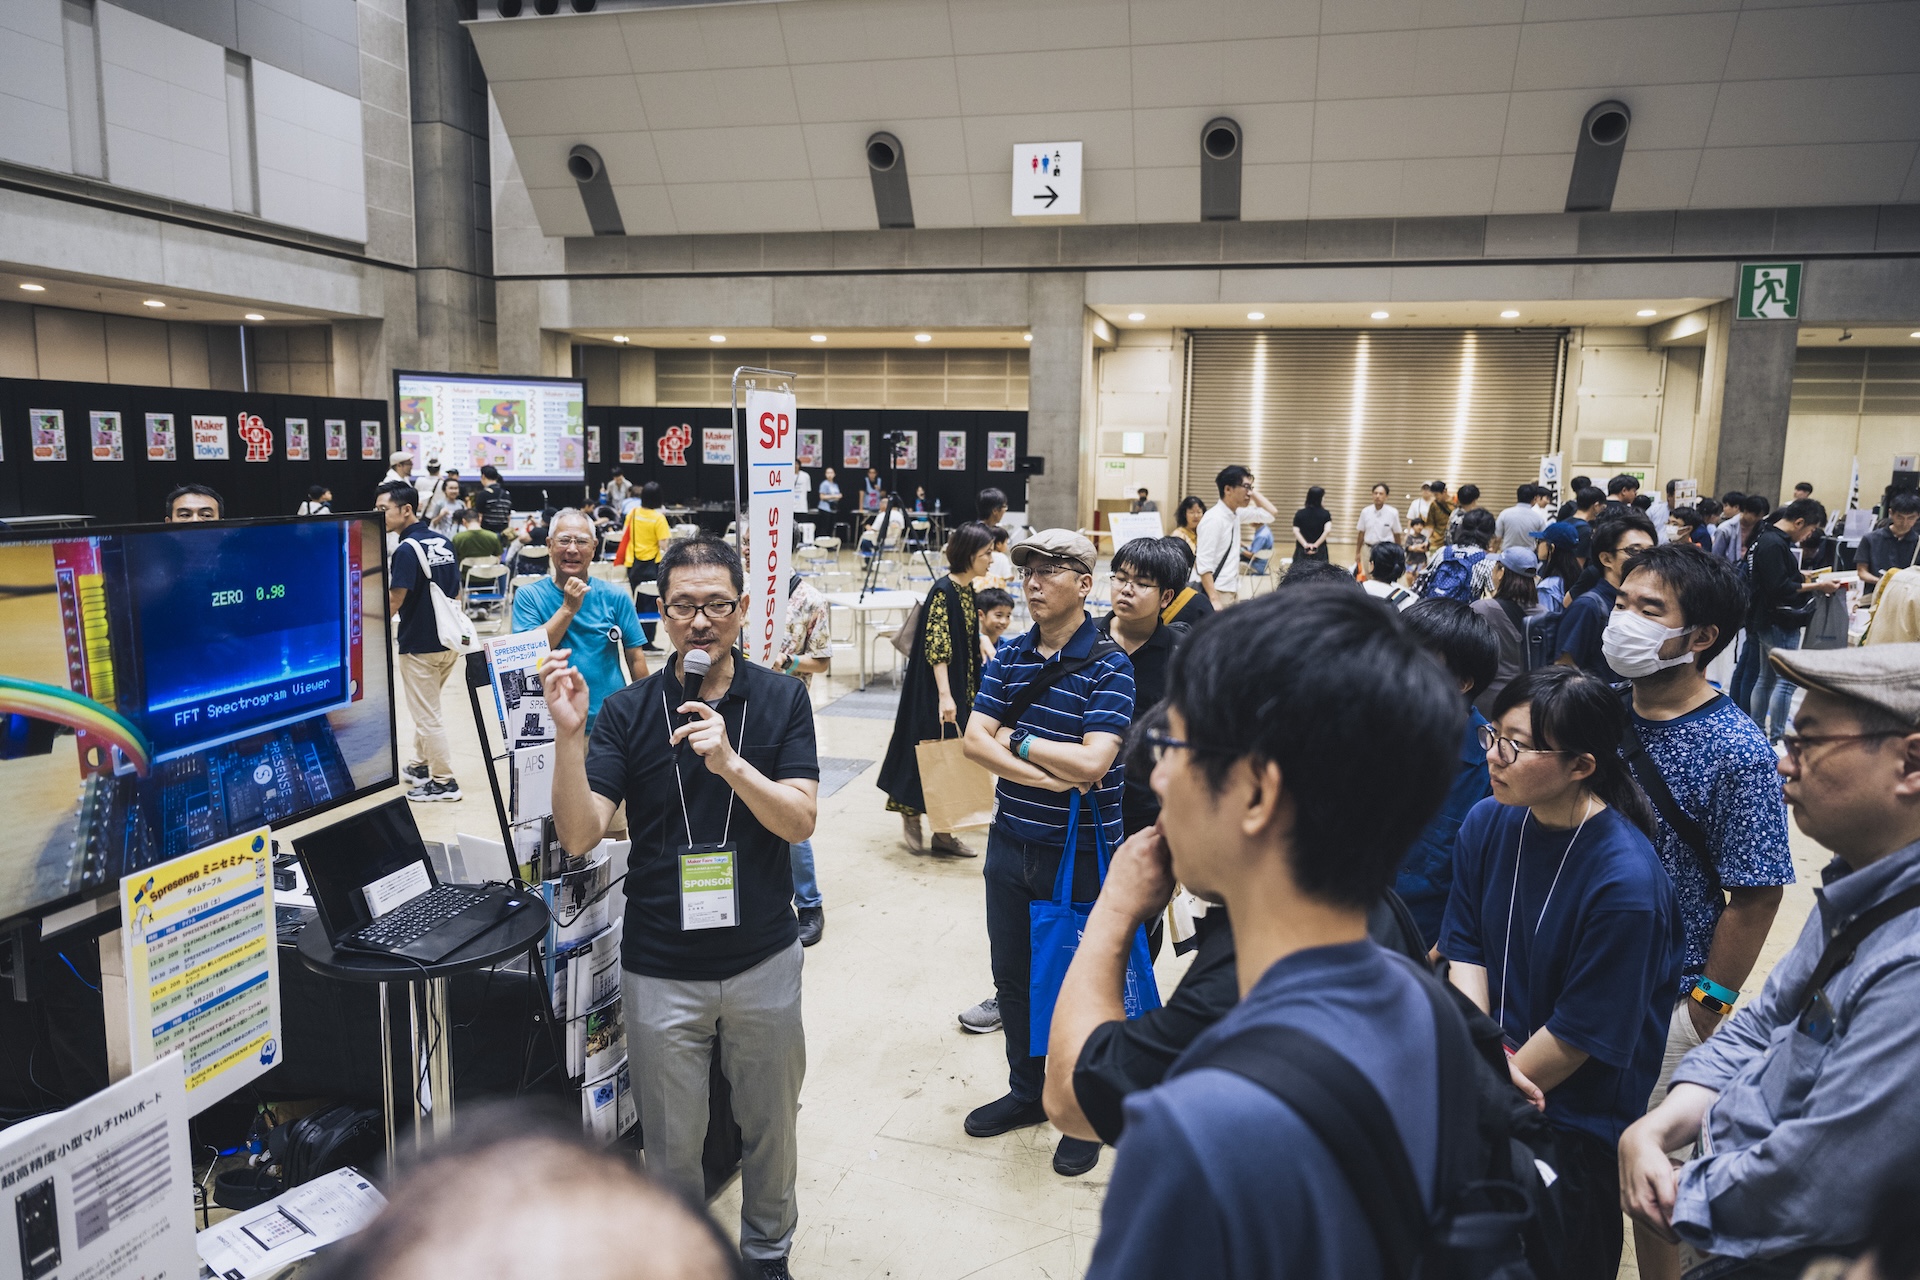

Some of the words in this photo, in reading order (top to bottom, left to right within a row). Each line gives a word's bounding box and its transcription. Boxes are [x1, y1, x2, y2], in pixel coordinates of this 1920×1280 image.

[194, 420, 224, 431] Maker
[759, 412, 789, 449] SP
[195, 433, 218, 443] Faire
[705, 432, 732, 440] Maker
[196, 445, 224, 457] Tokyo
[705, 443, 726, 451] Faire
[705, 452, 732, 463] Tokyo
[769, 470, 782, 487] 04
[763, 507, 779, 662] SPONSOR
[211, 589, 244, 607] ZERO
[255, 584, 286, 601] 0.98
[494, 640, 548, 657] SPRESENSEではじめる
[174, 708, 200, 727] FFT
[207, 690, 287, 718] Spectrogram
[292, 678, 330, 696] Viewer
[524, 753, 545, 773] APS
[149, 870, 200, 903] Spresense
[203, 853, 254, 875] ミニセミナー
[684, 877, 732, 888] SPONSOR
[187, 876, 223, 896] タイムテーブル
[181, 917, 197, 928] タイトル
[152, 986, 167, 997] 15:30
[187, 1008, 202, 1019] タイトル
[265, 1043, 273, 1053] AI
[1, 1092, 162, 1190] 超高精度小型マルチIMUボード
